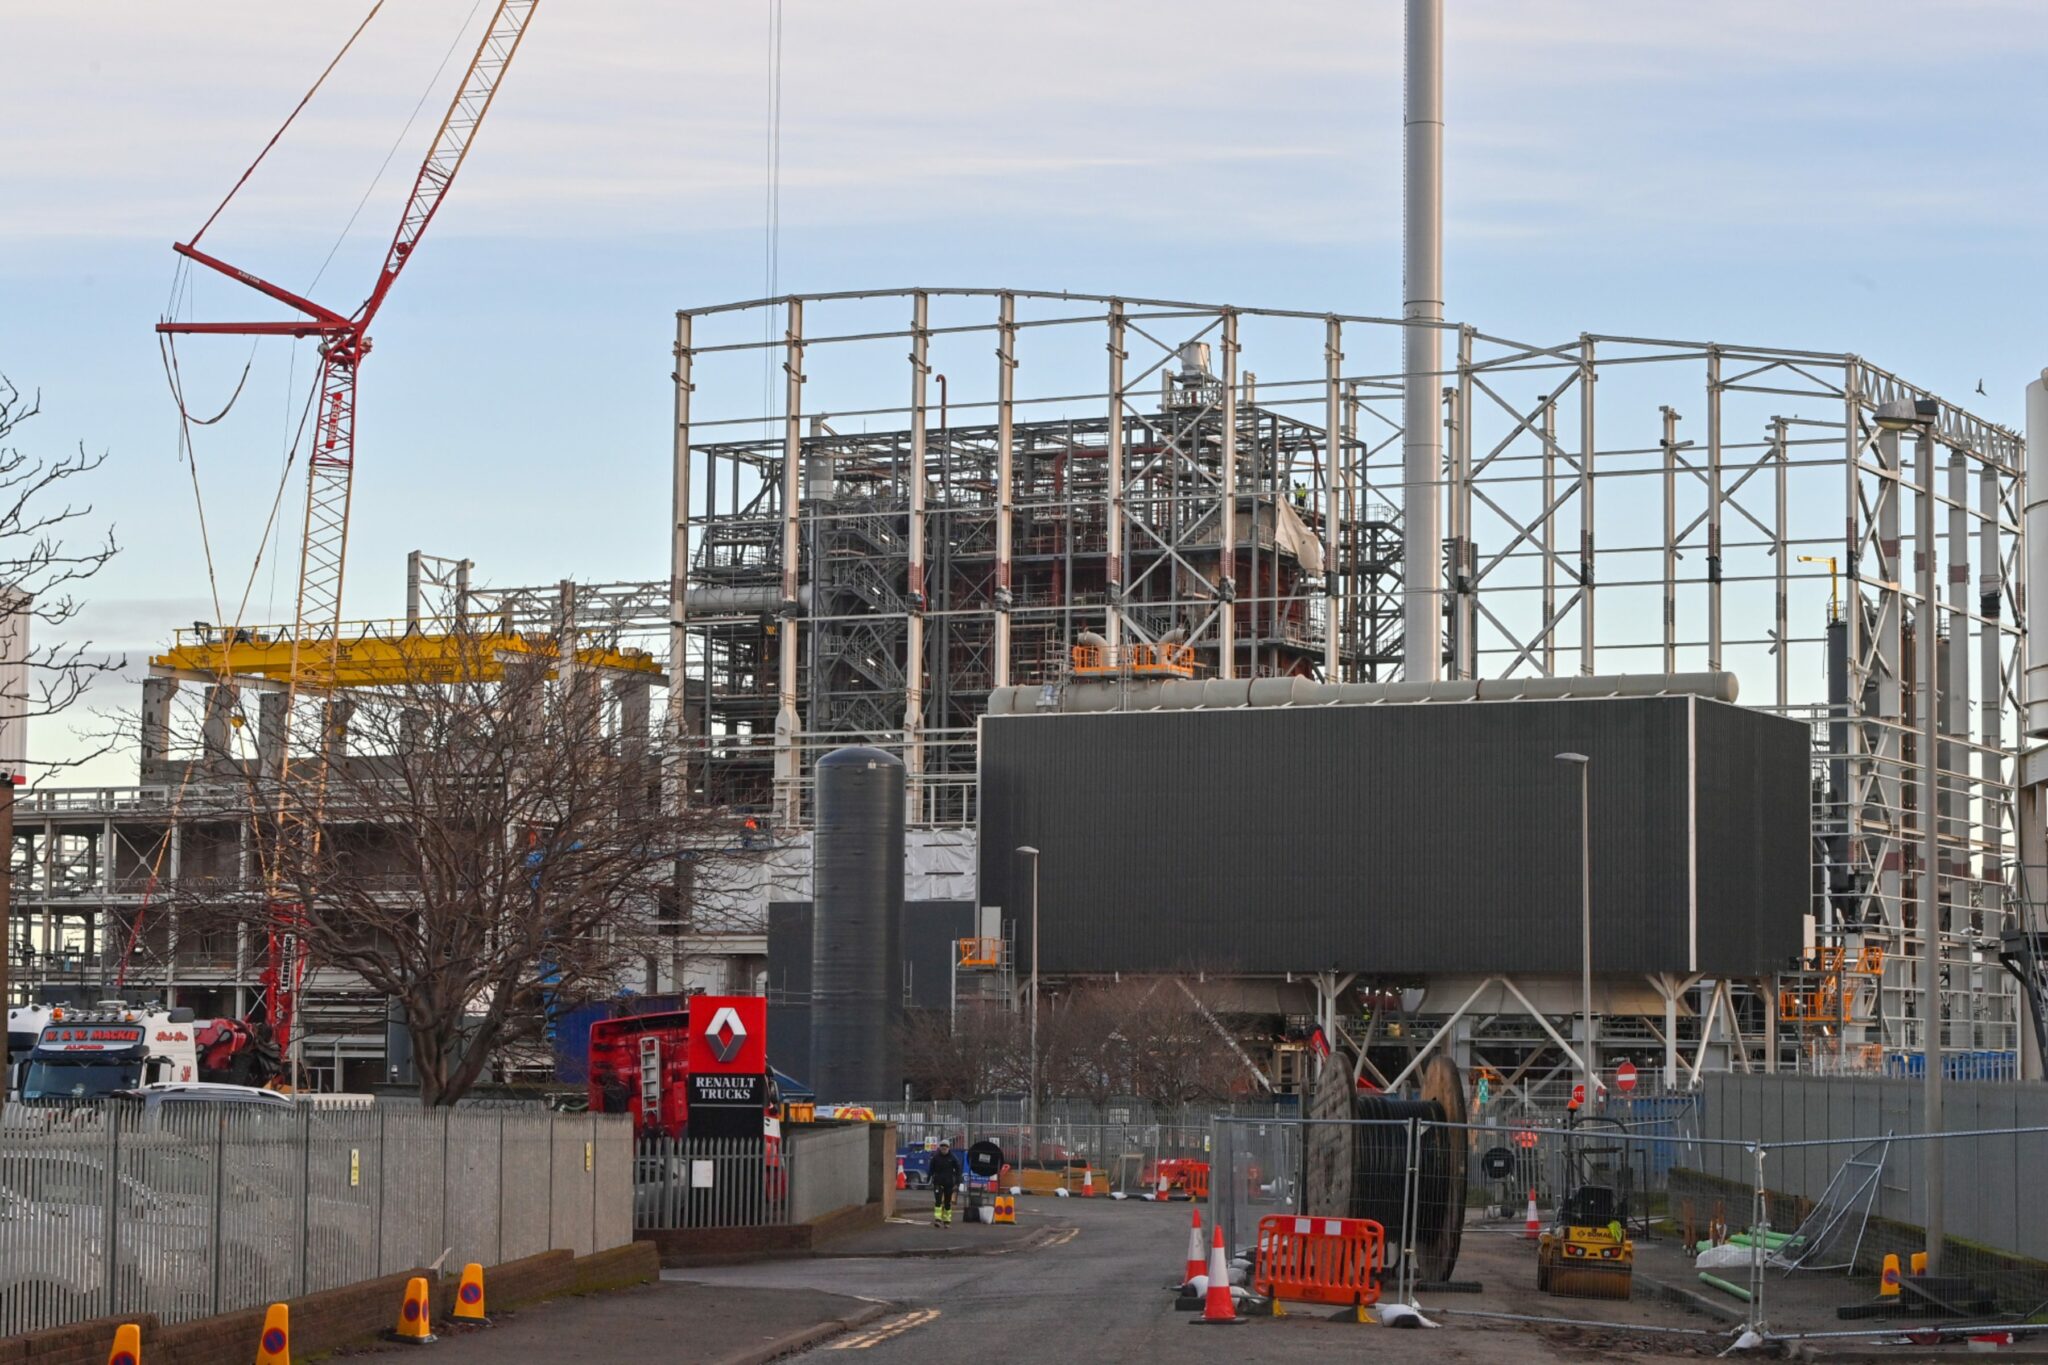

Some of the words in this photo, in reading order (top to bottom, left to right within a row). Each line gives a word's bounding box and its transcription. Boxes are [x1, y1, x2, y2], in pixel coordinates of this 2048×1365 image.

[328, 400, 341, 441] WELDEX
[61, 1030, 71, 1041] &
[75, 1030, 88, 1041] W.
[92, 1031, 139, 1041] MACKIE
[696, 1077, 756, 1088] RENAULT
[700, 1088, 751, 1099] TRUCKS
